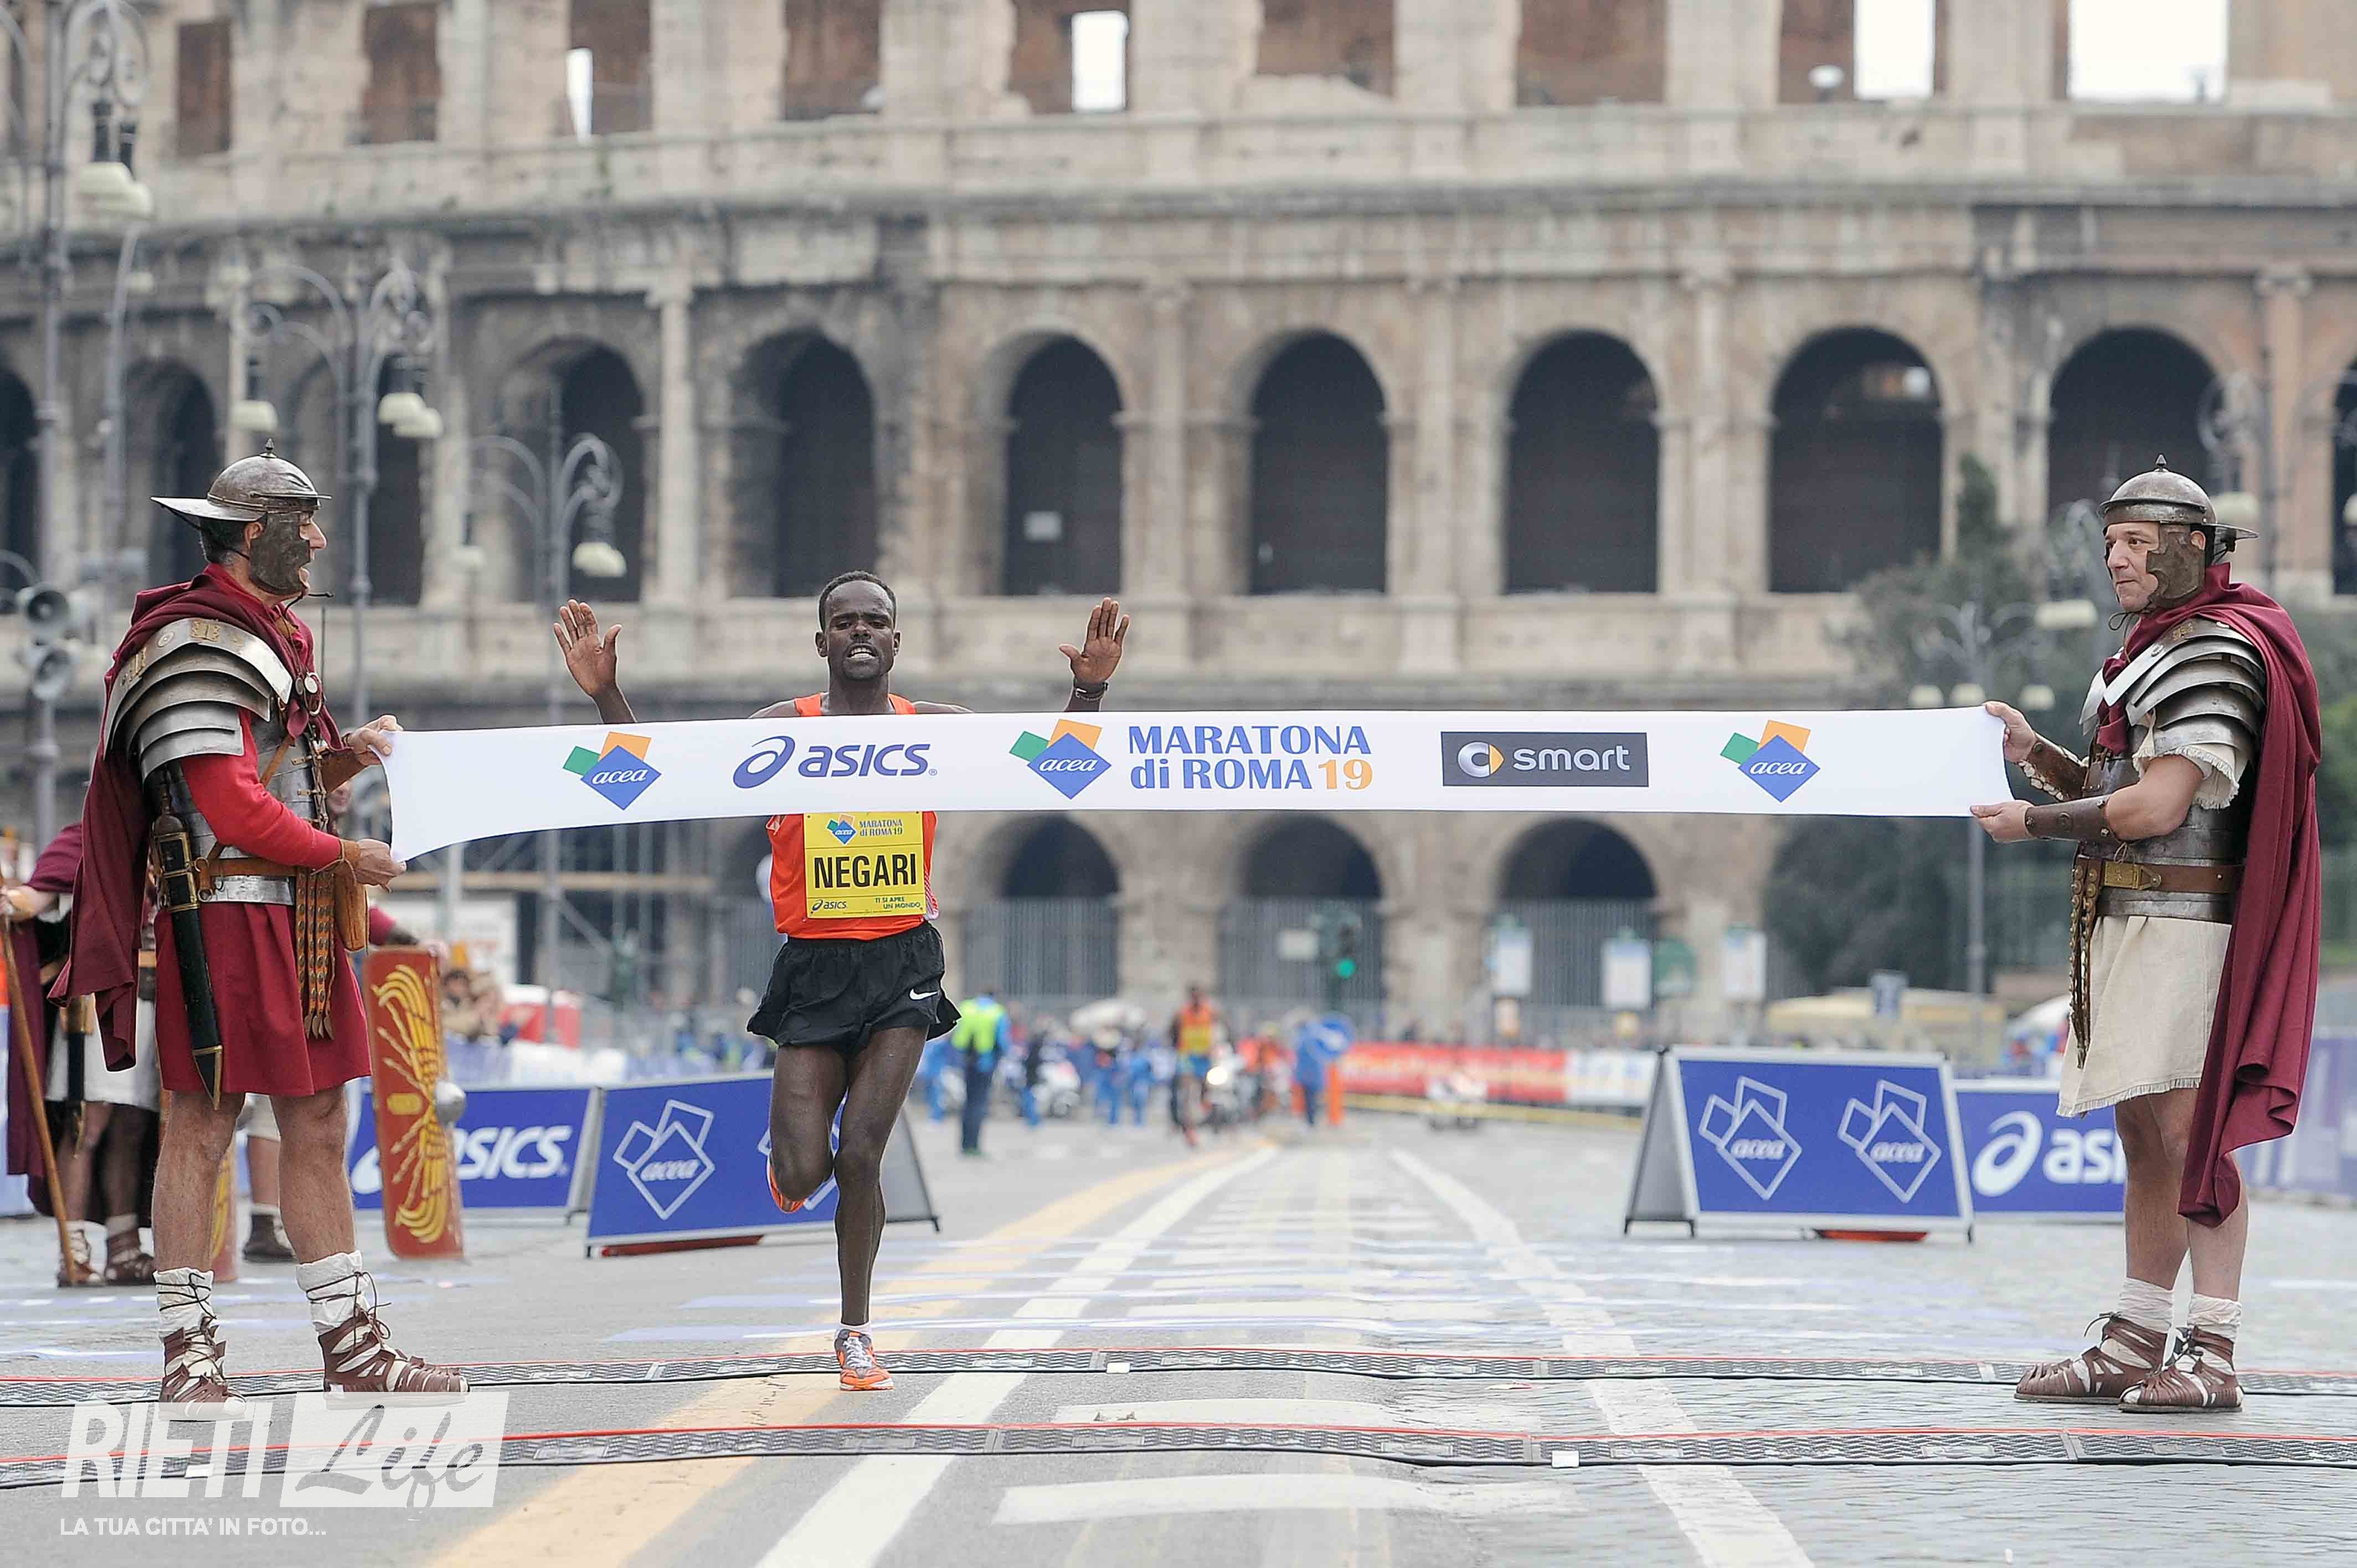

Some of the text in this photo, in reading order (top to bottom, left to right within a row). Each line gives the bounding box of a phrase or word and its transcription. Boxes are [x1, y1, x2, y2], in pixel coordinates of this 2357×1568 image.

[1129, 726, 1371, 755] MARATONA
[1038, 759, 1098, 773] acea
[1513, 745, 1630, 772] smart
[1749, 761, 1807, 775] acea
[591, 767, 647, 785] acea
[1130, 759, 1373, 790] di ROMA 19
[859, 819, 903, 828] MARATONA
[814, 853, 917, 889] NEGARI
